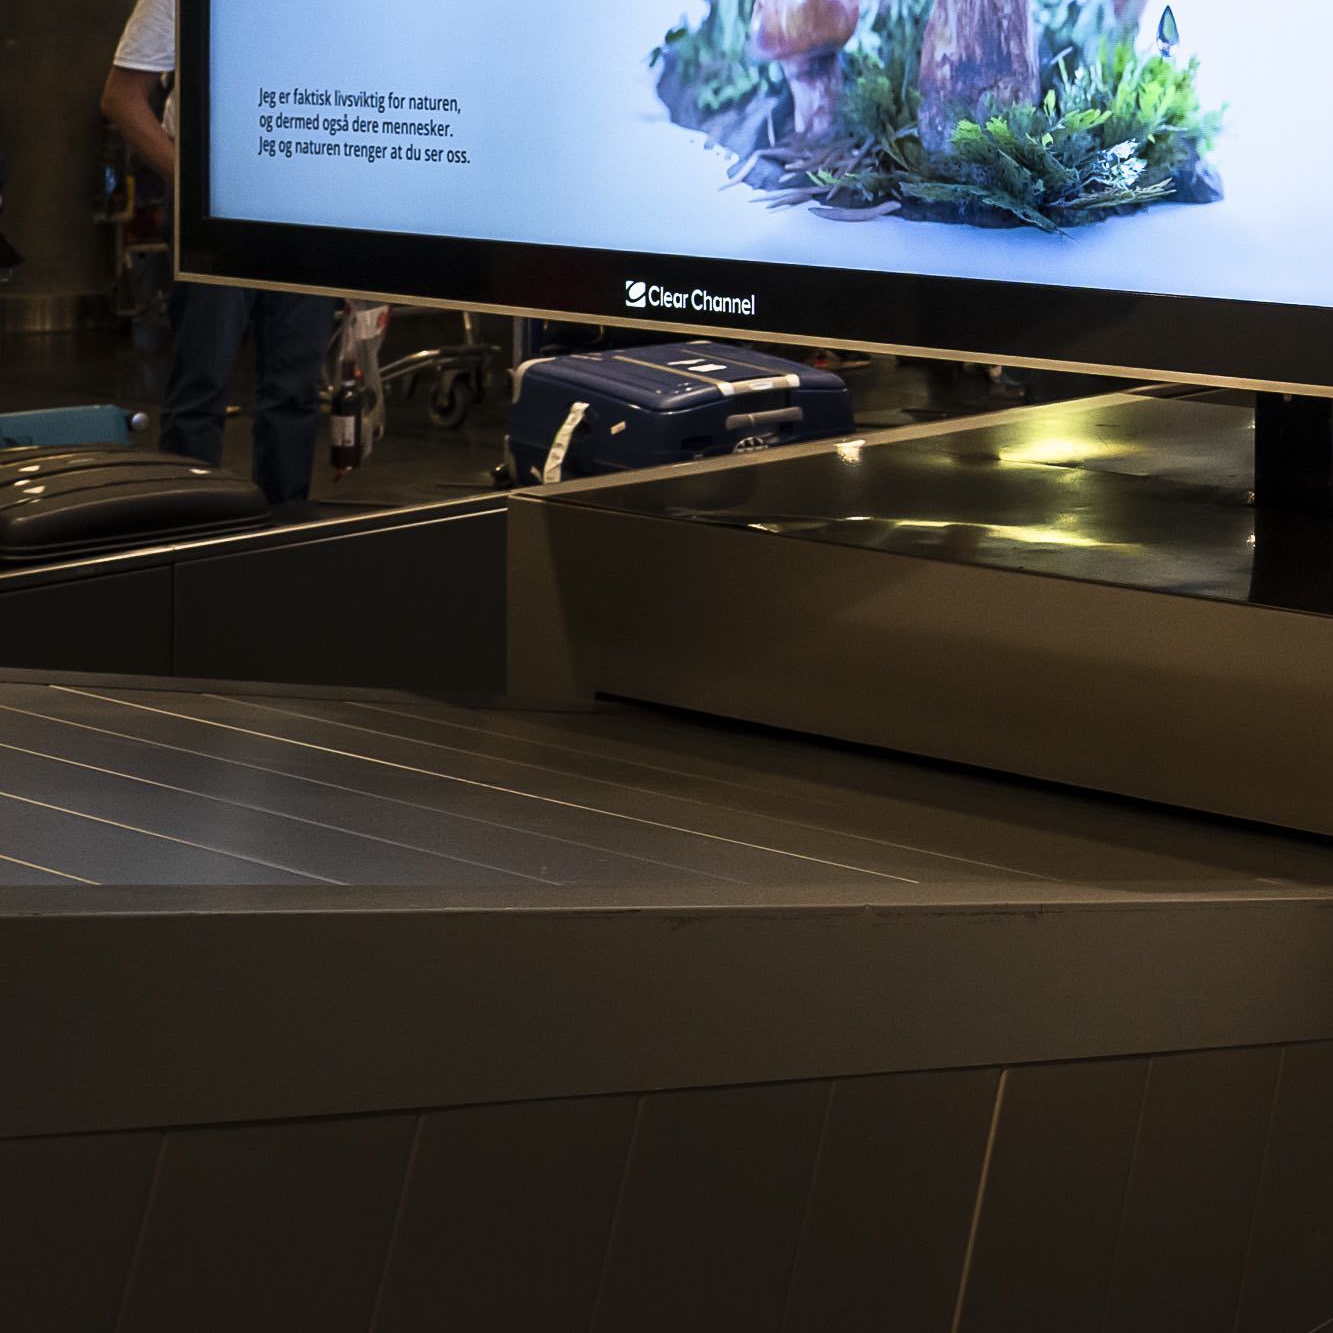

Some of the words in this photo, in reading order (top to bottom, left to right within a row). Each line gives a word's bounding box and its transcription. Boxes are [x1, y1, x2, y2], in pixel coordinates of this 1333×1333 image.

[258, 87, 276, 108] Jeg
[279, 91, 291, 104] er
[293, 88, 332, 106] faktisk
[334, 90, 385, 113] livsviktig
[388, 91, 406, 109] for
[409, 95, 461, 114] naturen,
[259, 114, 273, 132] og
[275, 112, 320, 130] dermed
[322, 114, 349, 136] også
[352, 116, 379, 133] dere
[382, 119, 454, 137] mennesker.
[258, 136, 276, 157] Jeg
[278, 139, 292, 158] og
[295, 139, 341, 156] naturen
[343, 141, 387, 163] trenger
[390, 145, 403, 160] at
[405, 144, 421, 161] du
[424, 148, 444, 162] ser
[446, 149, 471, 164] oss.
[648, 285, 689, 309] Clear
[691, 288, 755, 315] Channel
